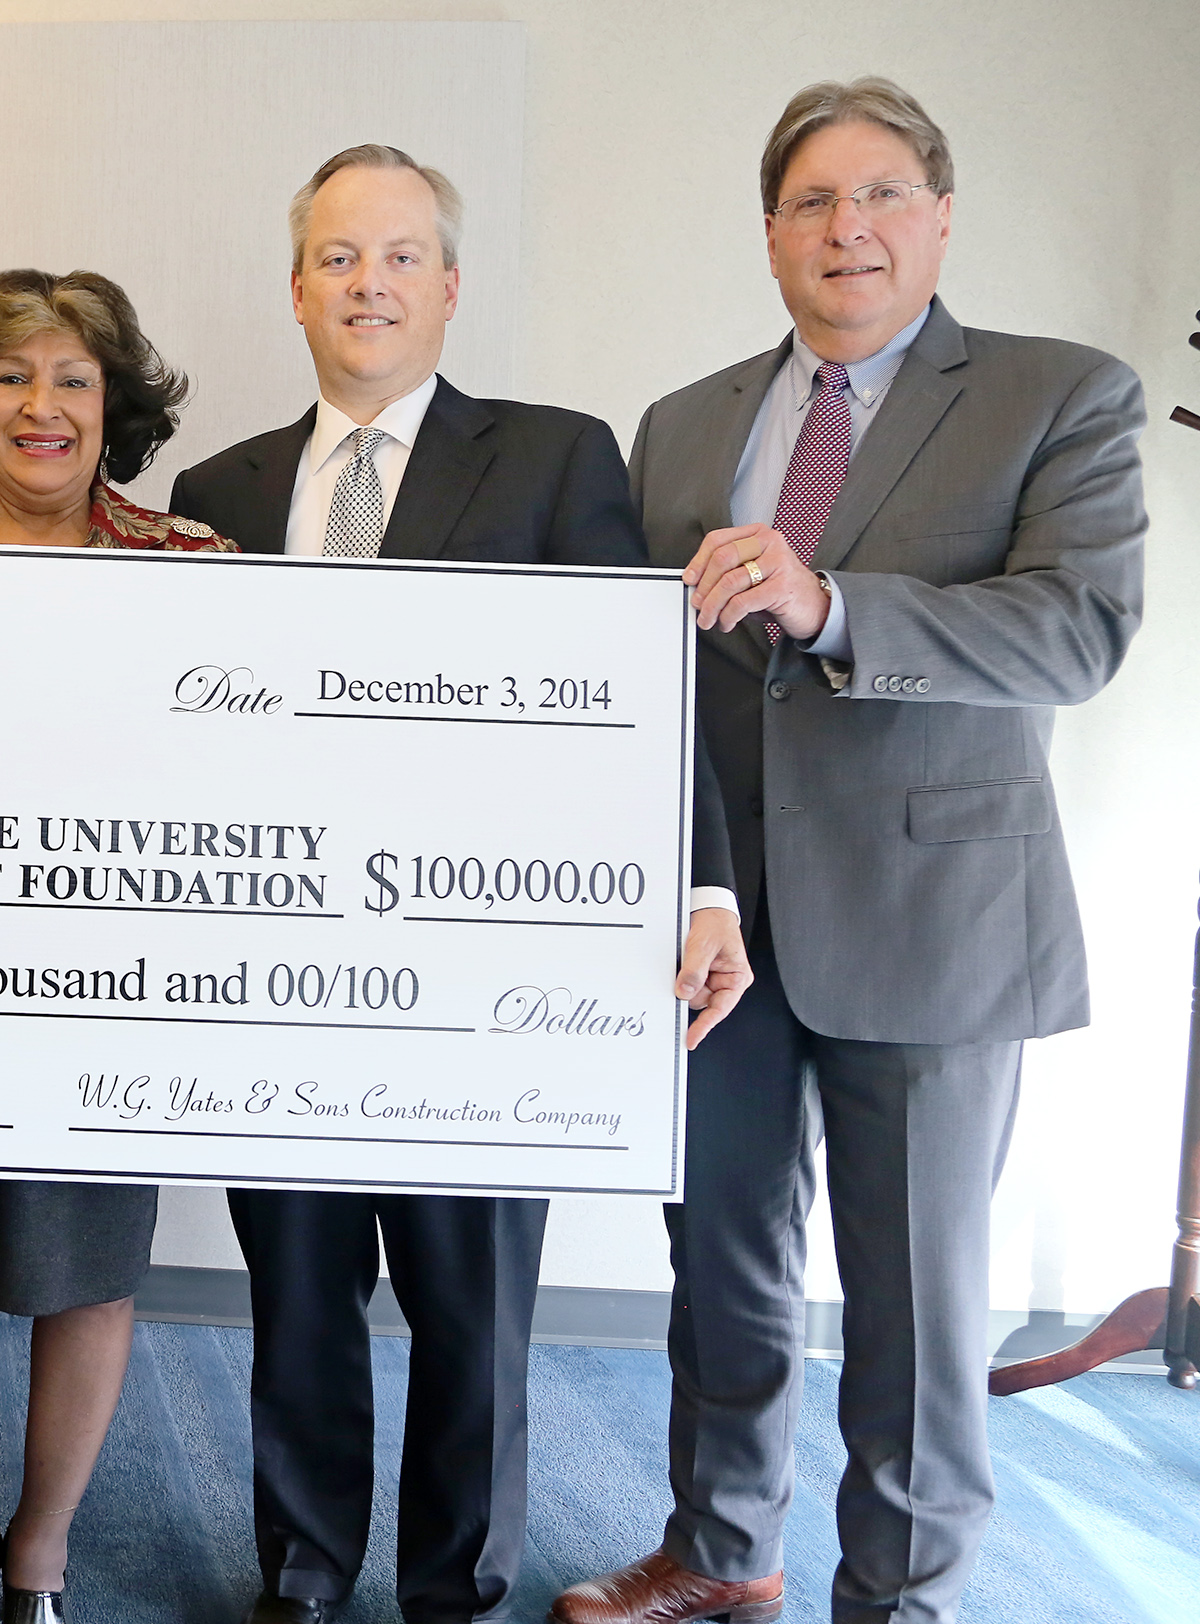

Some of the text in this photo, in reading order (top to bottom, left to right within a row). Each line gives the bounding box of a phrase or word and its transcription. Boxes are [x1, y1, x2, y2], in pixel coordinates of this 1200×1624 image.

[169, 665, 611, 715] Date December 3, 2014
[37, 816, 327, 861] UNIVERSITY
[18, 863, 327, 909] FOUNDATION
[165, 961, 249, 1005] and
[267, 963, 420, 1011] 00/100
[487, 985, 646, 1037] Dollars
[78, 1073, 622, 1136] W.G. Yates & Sons Construction Company
